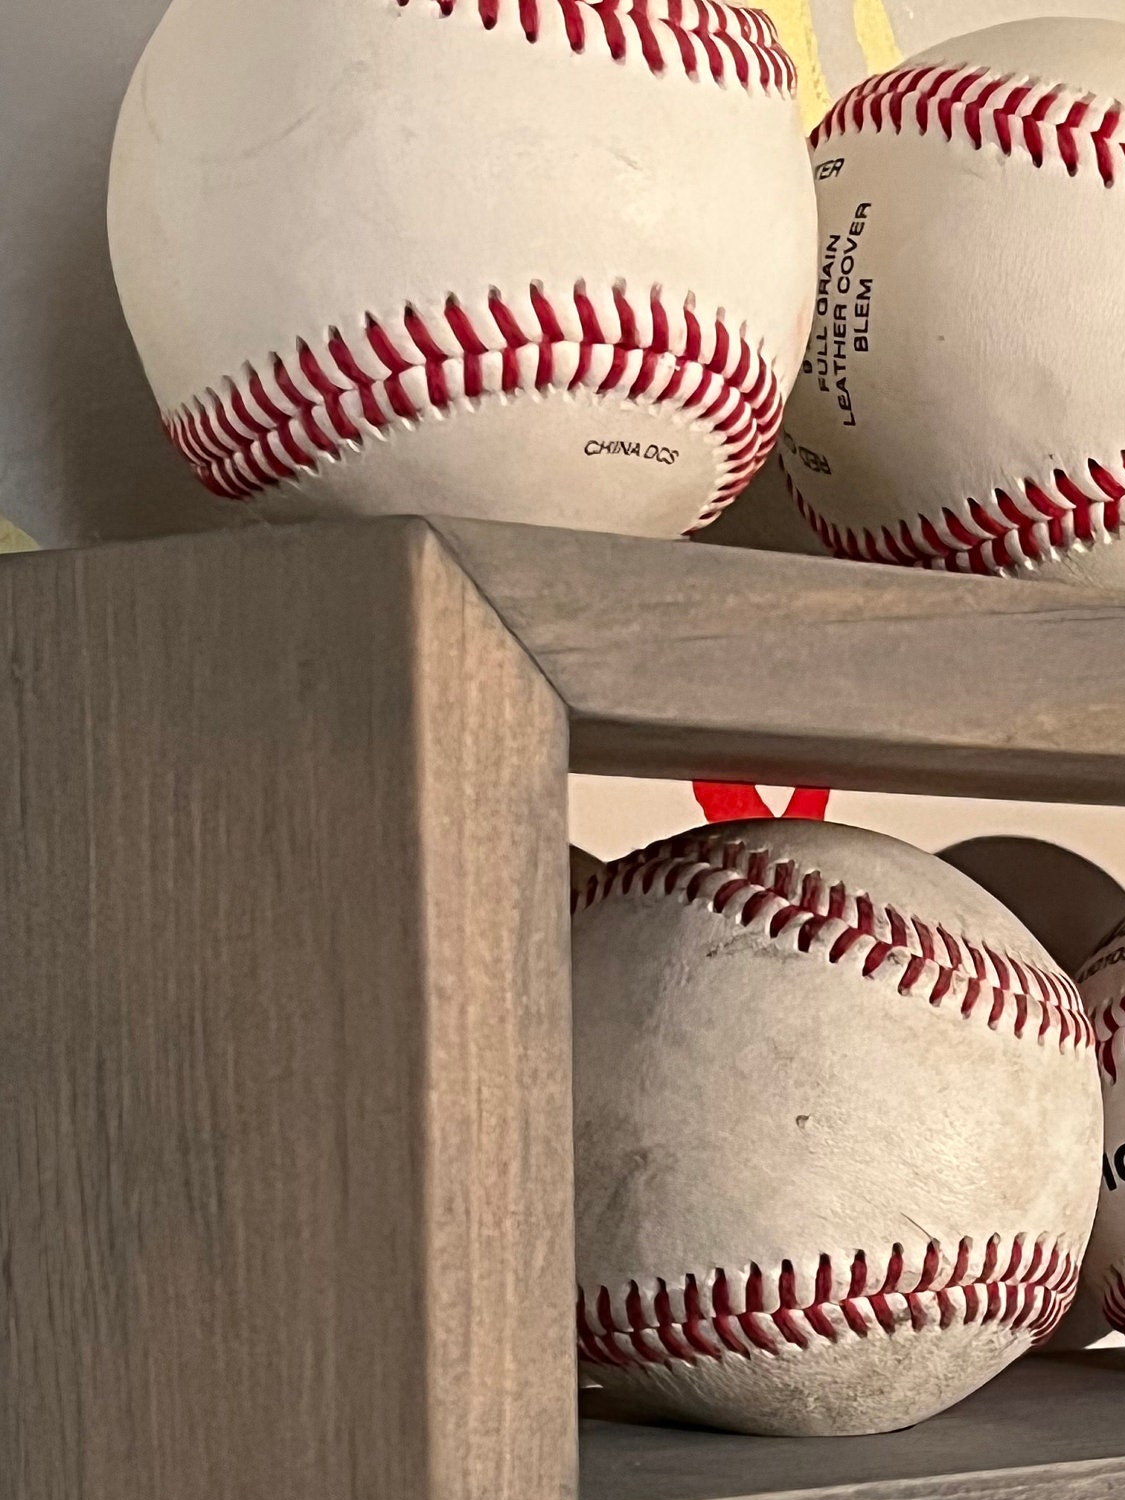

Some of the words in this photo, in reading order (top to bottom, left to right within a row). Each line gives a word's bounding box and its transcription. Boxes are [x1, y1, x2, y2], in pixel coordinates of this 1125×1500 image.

[836, 202, 872, 295] COVER
[853, 278, 874, 353] BLEM
[816, 325, 831, 393] FULL
[833, 303, 857, 427] LEATHER
